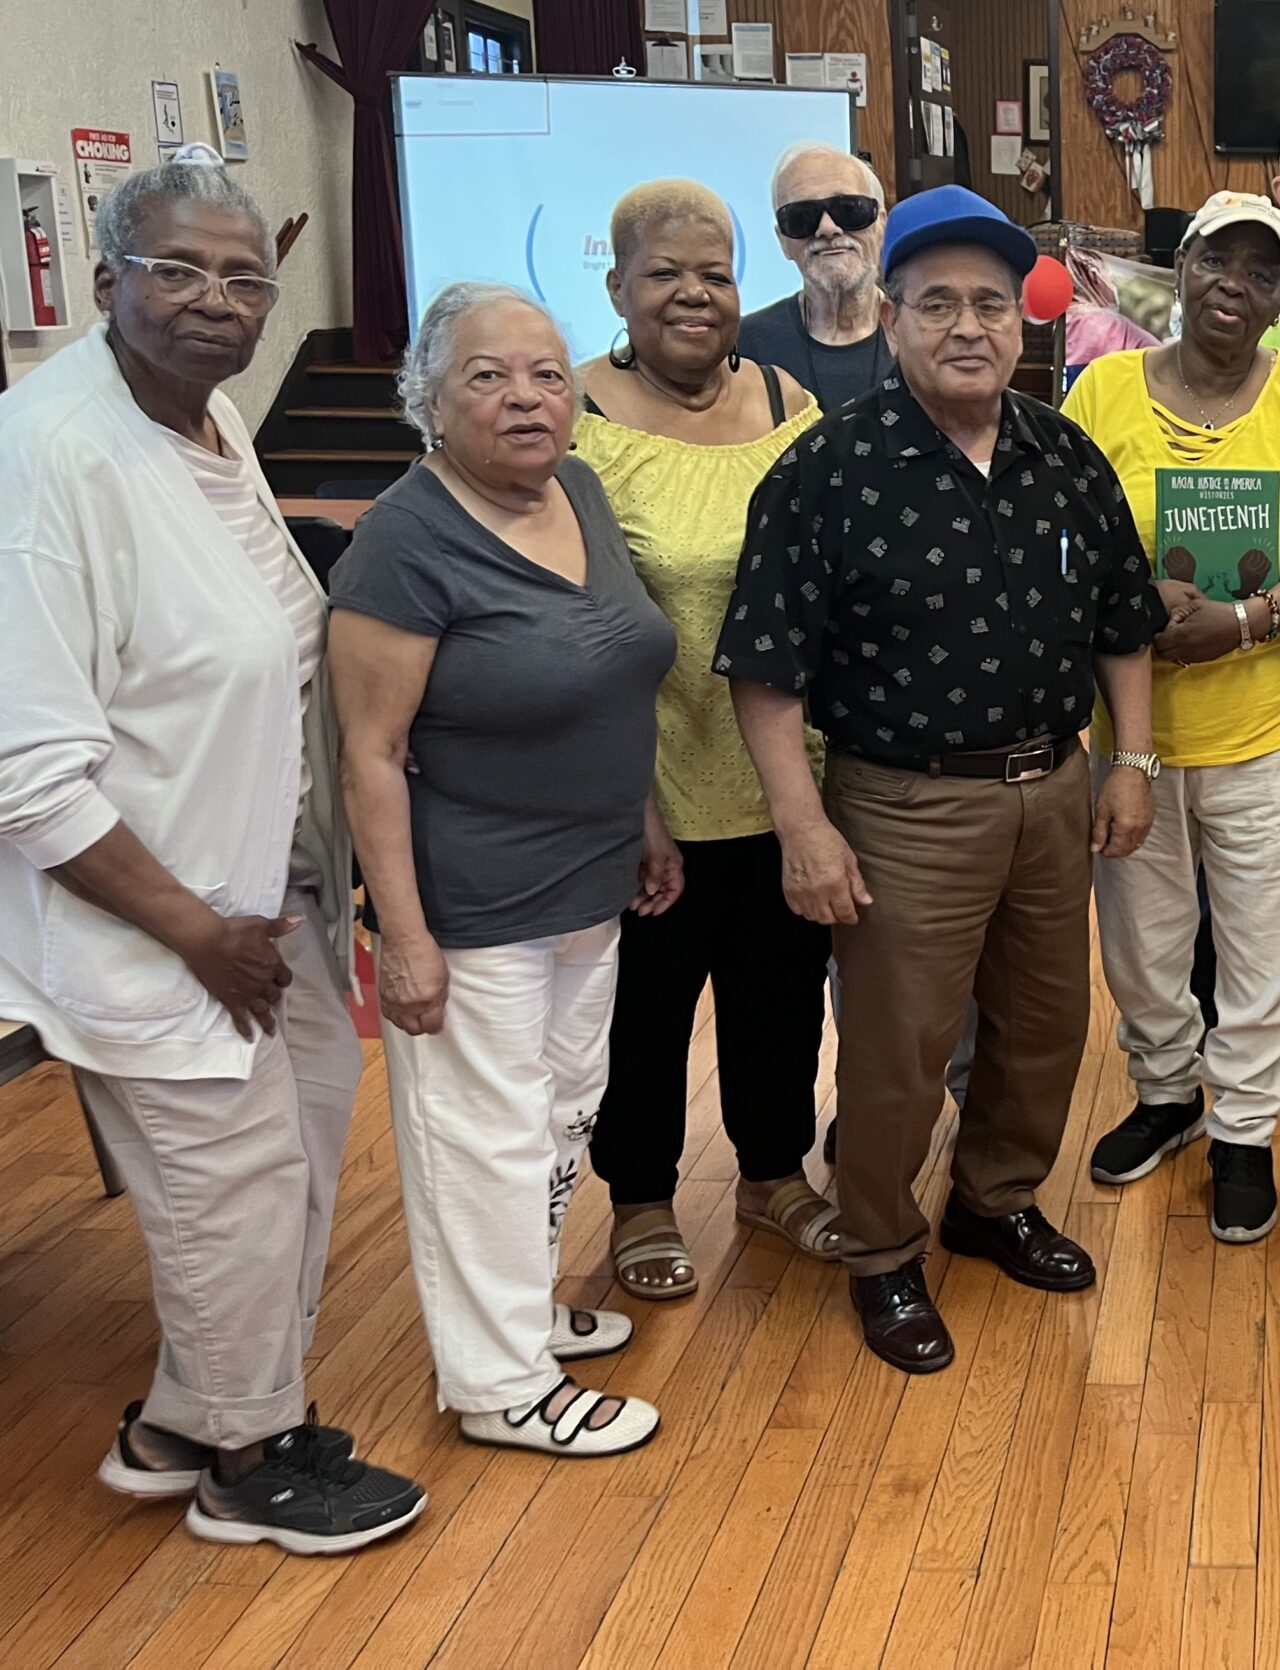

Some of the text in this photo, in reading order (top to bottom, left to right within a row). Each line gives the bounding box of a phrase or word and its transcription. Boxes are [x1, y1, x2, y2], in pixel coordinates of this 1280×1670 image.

[76, 140, 129, 161] CHOKING
[1171, 476, 1194, 489] RACIAL
[1197, 477, 1221, 490] JUSTICE
[1231, 478, 1262, 490] AMERICA
[1200, 490, 1235, 500] HISTORIES
[1164, 503, 1270, 533] JUNETEENTH
